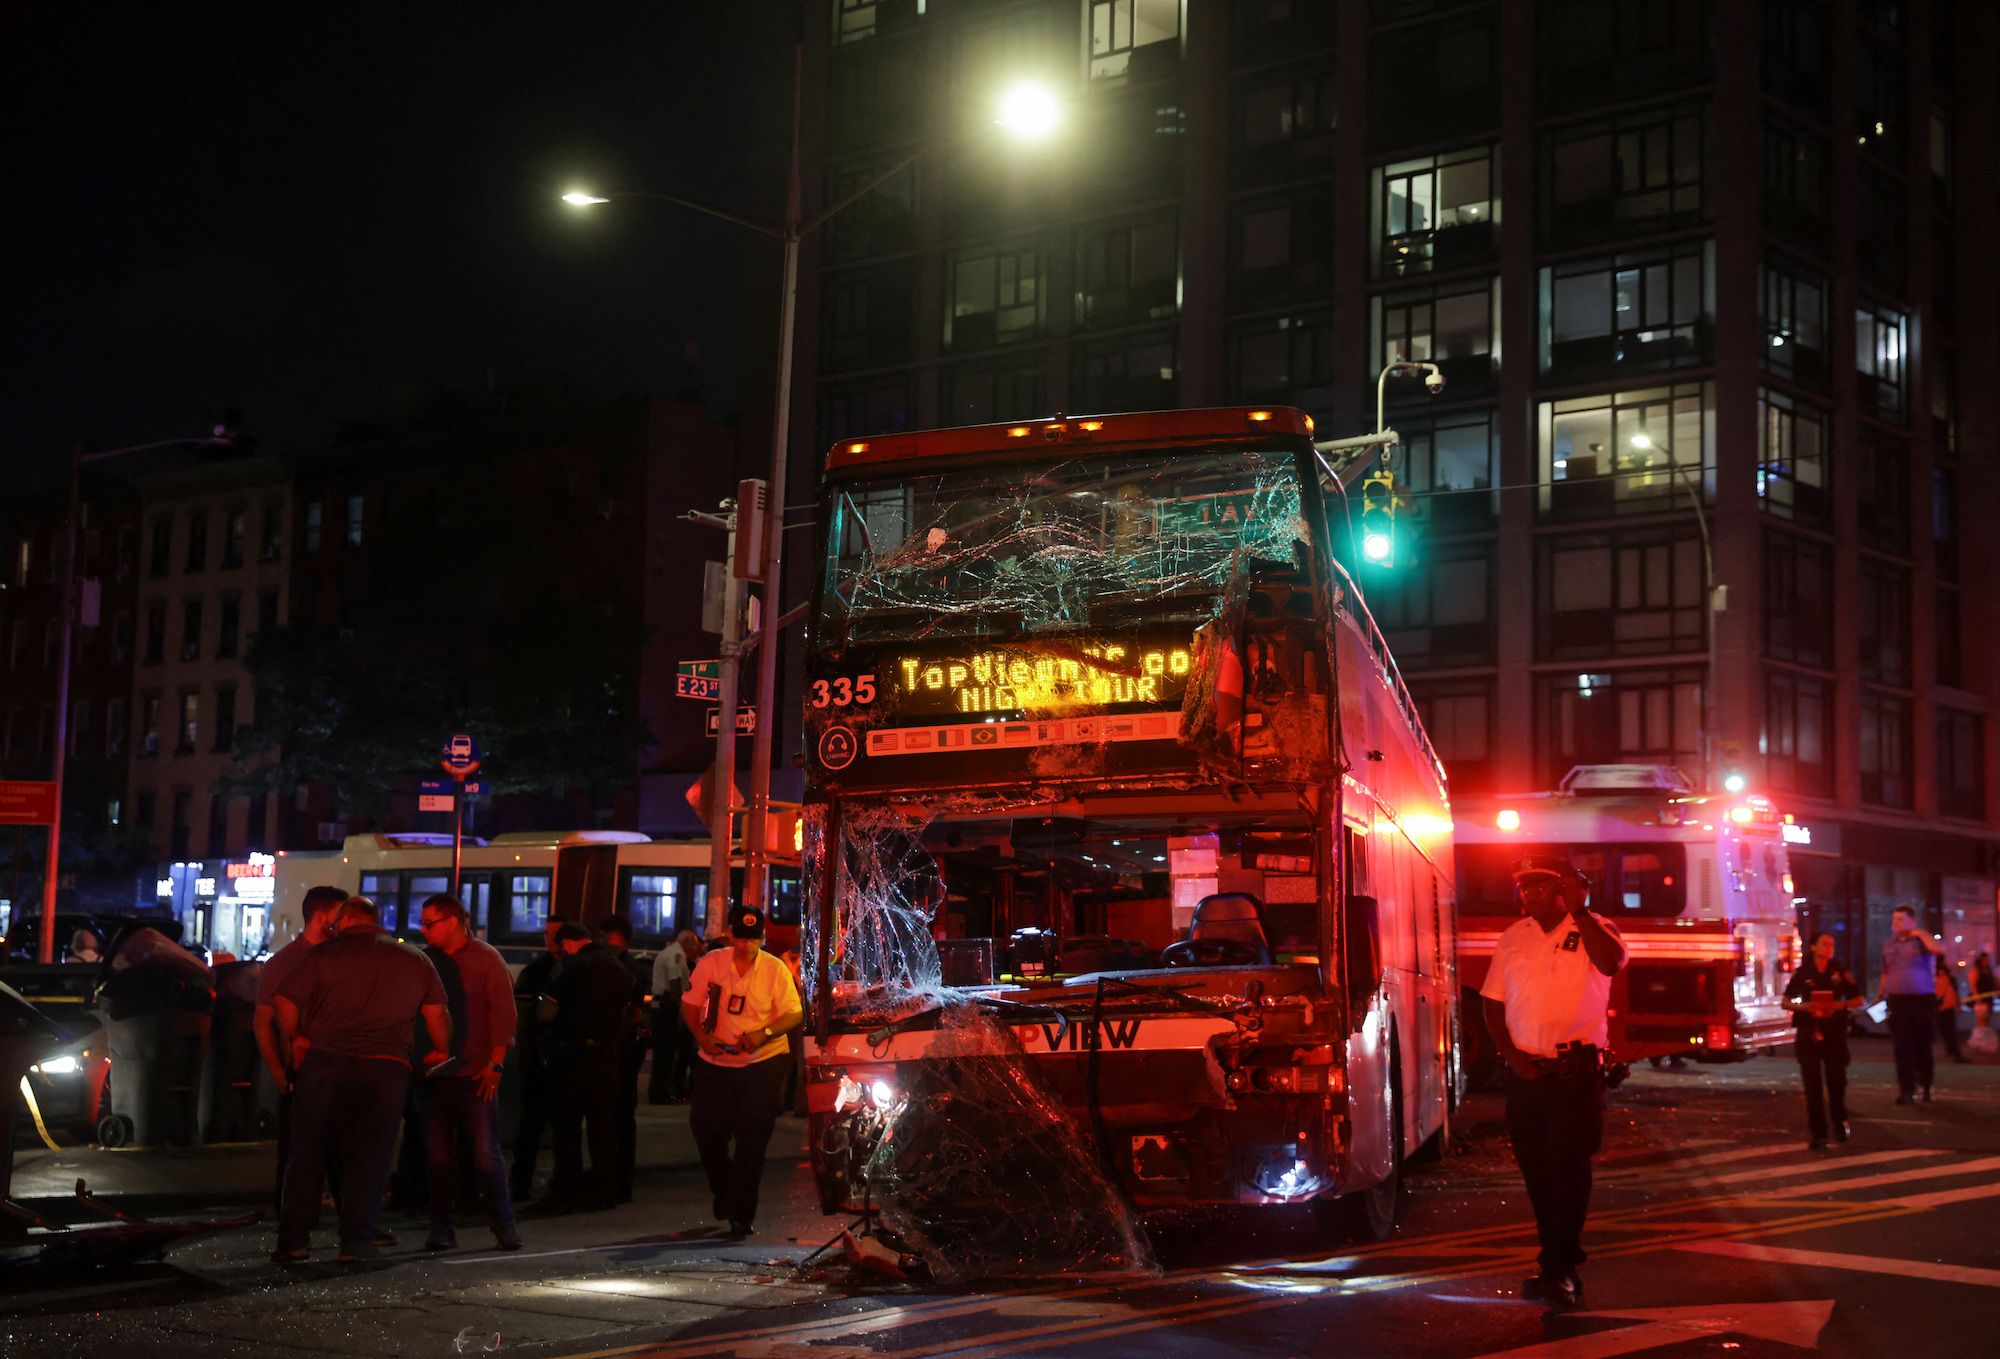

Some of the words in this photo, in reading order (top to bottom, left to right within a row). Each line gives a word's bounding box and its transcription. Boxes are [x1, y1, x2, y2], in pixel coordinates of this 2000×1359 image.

[691, 663, 697, 677] 1
[677, 677, 687, 694] E
[689, 679, 708, 697] 23
[709, 681, 719, 690] ST
[812, 674, 876, 709] 335
[1073, 676, 1157, 704] TOUR
